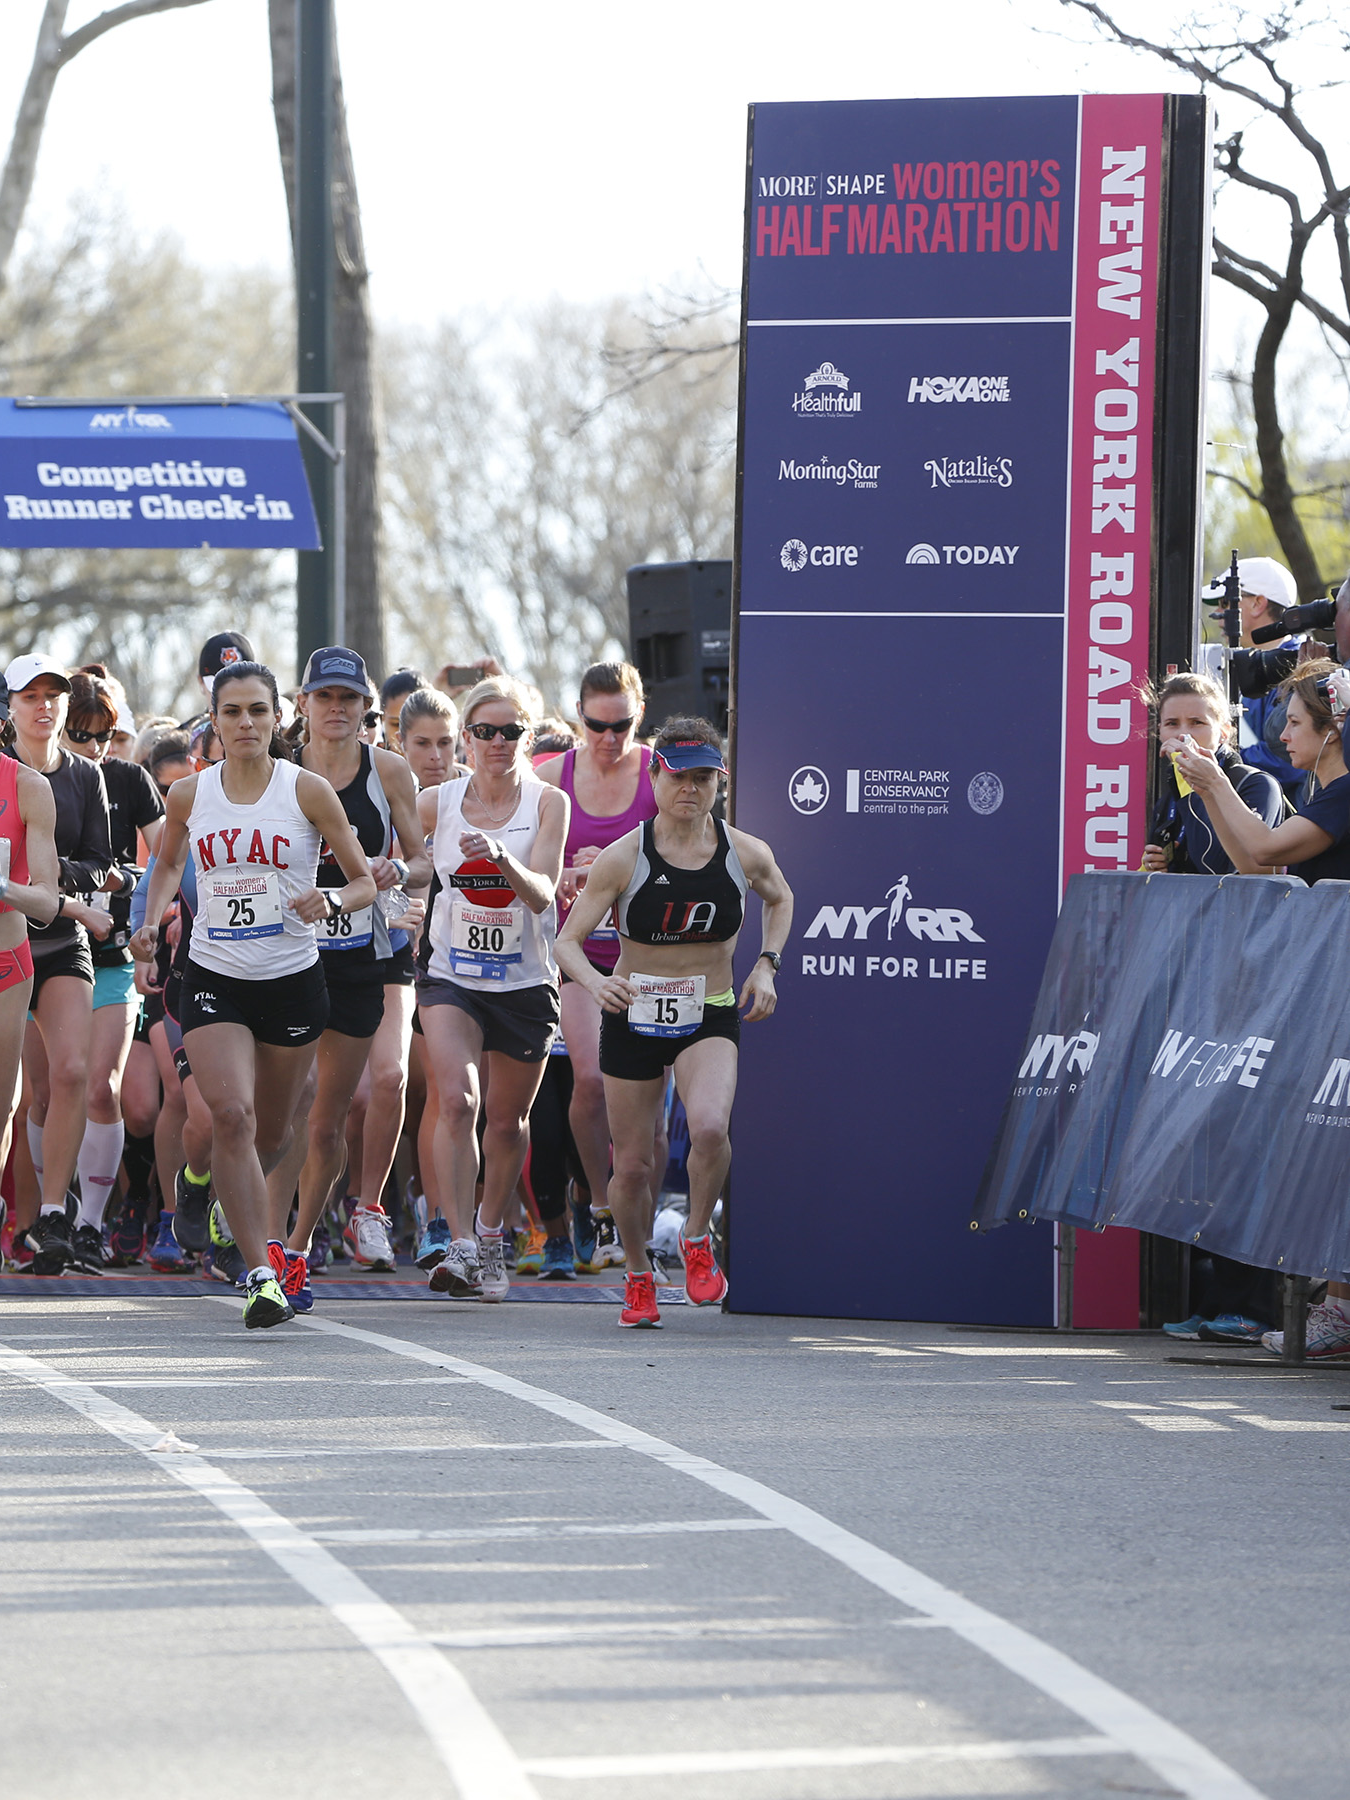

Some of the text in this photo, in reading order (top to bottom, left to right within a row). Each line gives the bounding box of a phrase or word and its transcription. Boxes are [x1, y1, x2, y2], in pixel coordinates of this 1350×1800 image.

[758, 175, 817, 197] MORE
[826, 174, 885, 195] SHAPE
[756, 201, 1060, 257] HALF MARATHON
[812, 375, 842, 383] ARNOLD
[907, 377, 1009, 403] HOKA ONE
[980, 389, 1010, 402] ONE
[792, 392, 861, 412] Healthfull
[37, 461, 247, 491] Competitive
[778, 457, 881, 486] MorningStar
[854, 479, 878, 489] Farms
[4, 494, 294, 520] Runner Check-in
[1084, 146, 1147, 872] NEW YORK ROAD RU
[810, 545, 859, 566] care
[943, 545, 1020, 565] TODAY
[864, 769, 949, 783] CENTRAL PARK
[863, 785, 950, 798] CONSERVANCY
[863, 803, 949, 816] central to the park
[198, 828, 291, 872] NYAC
[213, 884, 267, 894] HALF MARATHON
[235, 877, 266, 885] women's
[227, 898, 255, 926] 25
[462, 912, 513, 925] HALF MARATHON
[661, 901, 717, 934] UA
[468, 926, 504, 952] 810
[651, 932, 680, 941] Urban
[802, 954, 987, 980] RUN FOR LIFE
[640, 985, 695, 994] HALF MARATHON
[655, 998, 679, 1024] 15
